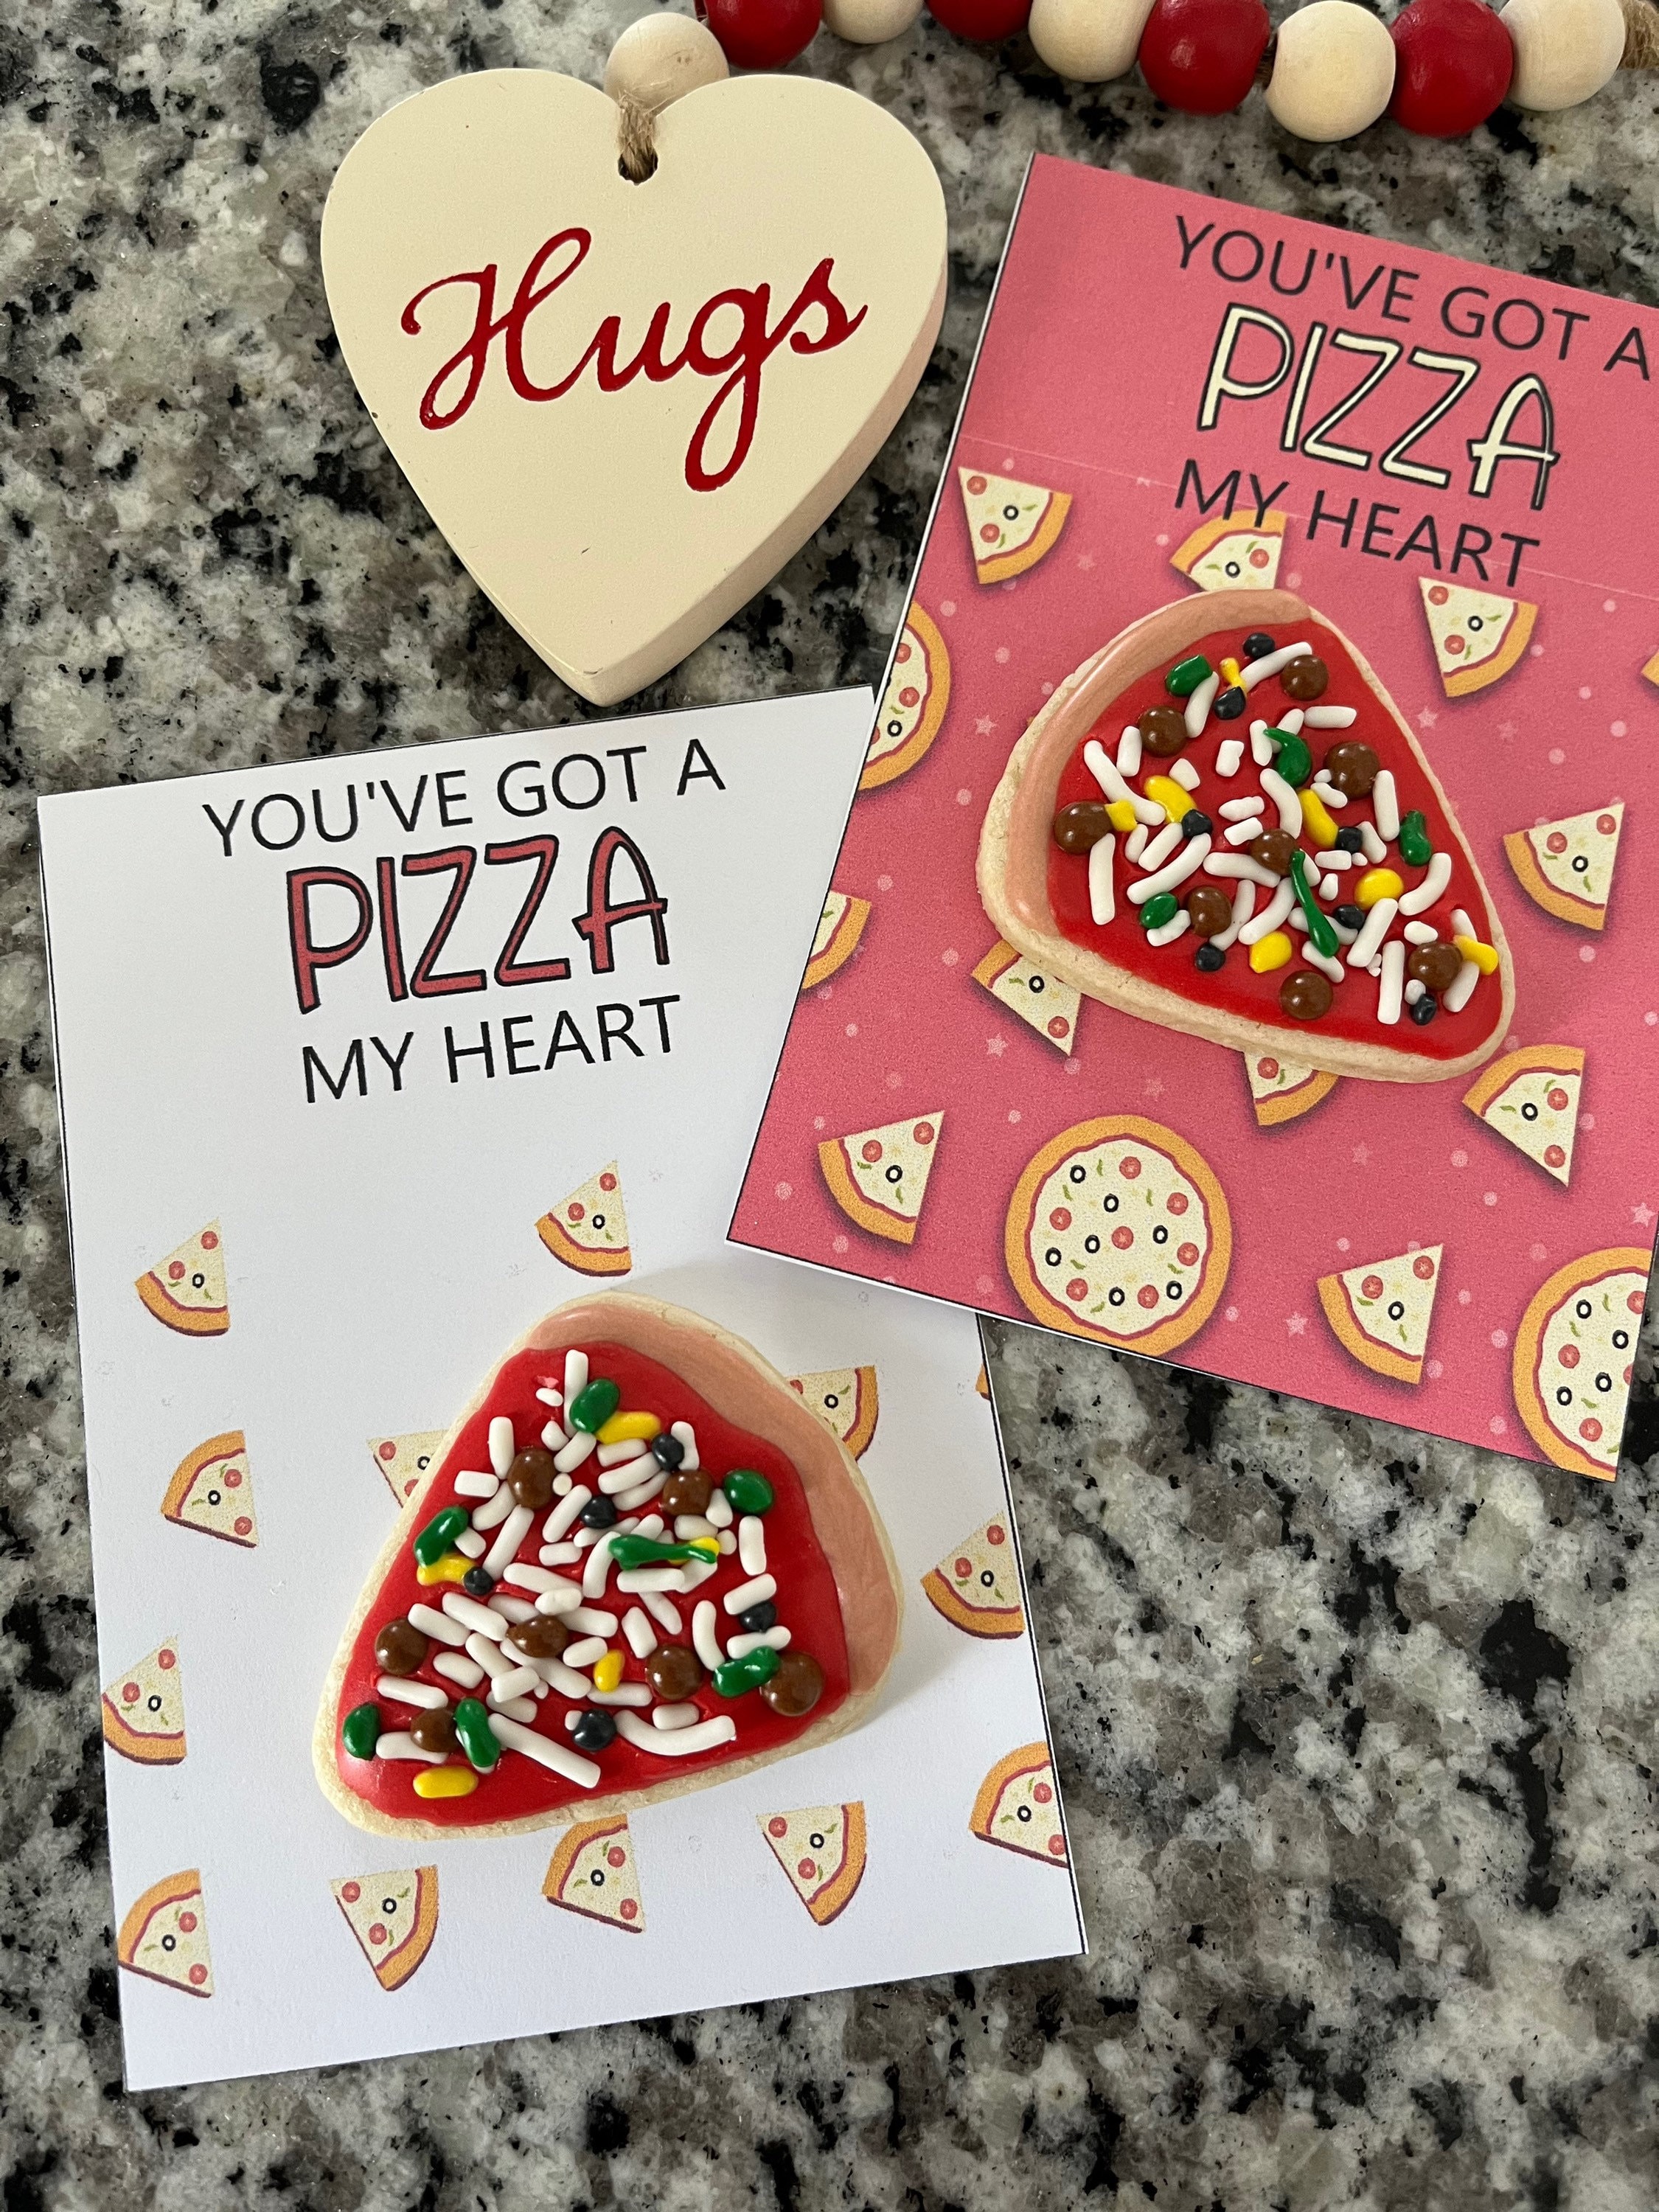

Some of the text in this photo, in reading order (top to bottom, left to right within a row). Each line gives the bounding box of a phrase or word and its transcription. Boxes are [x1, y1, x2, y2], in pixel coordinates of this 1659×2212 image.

[401, 227, 869, 493] Hugs
[1175, 215, 1650, 380] YOU'VE GOT A
[1197, 302, 1561, 510] PIZZA
[1175, 459, 1540, 588] MY HEART
[201, 738, 726, 858] YOU'VE GOT A
[285, 825, 670, 1015] PIZZA
[302, 994, 681, 1104] MY HEART
